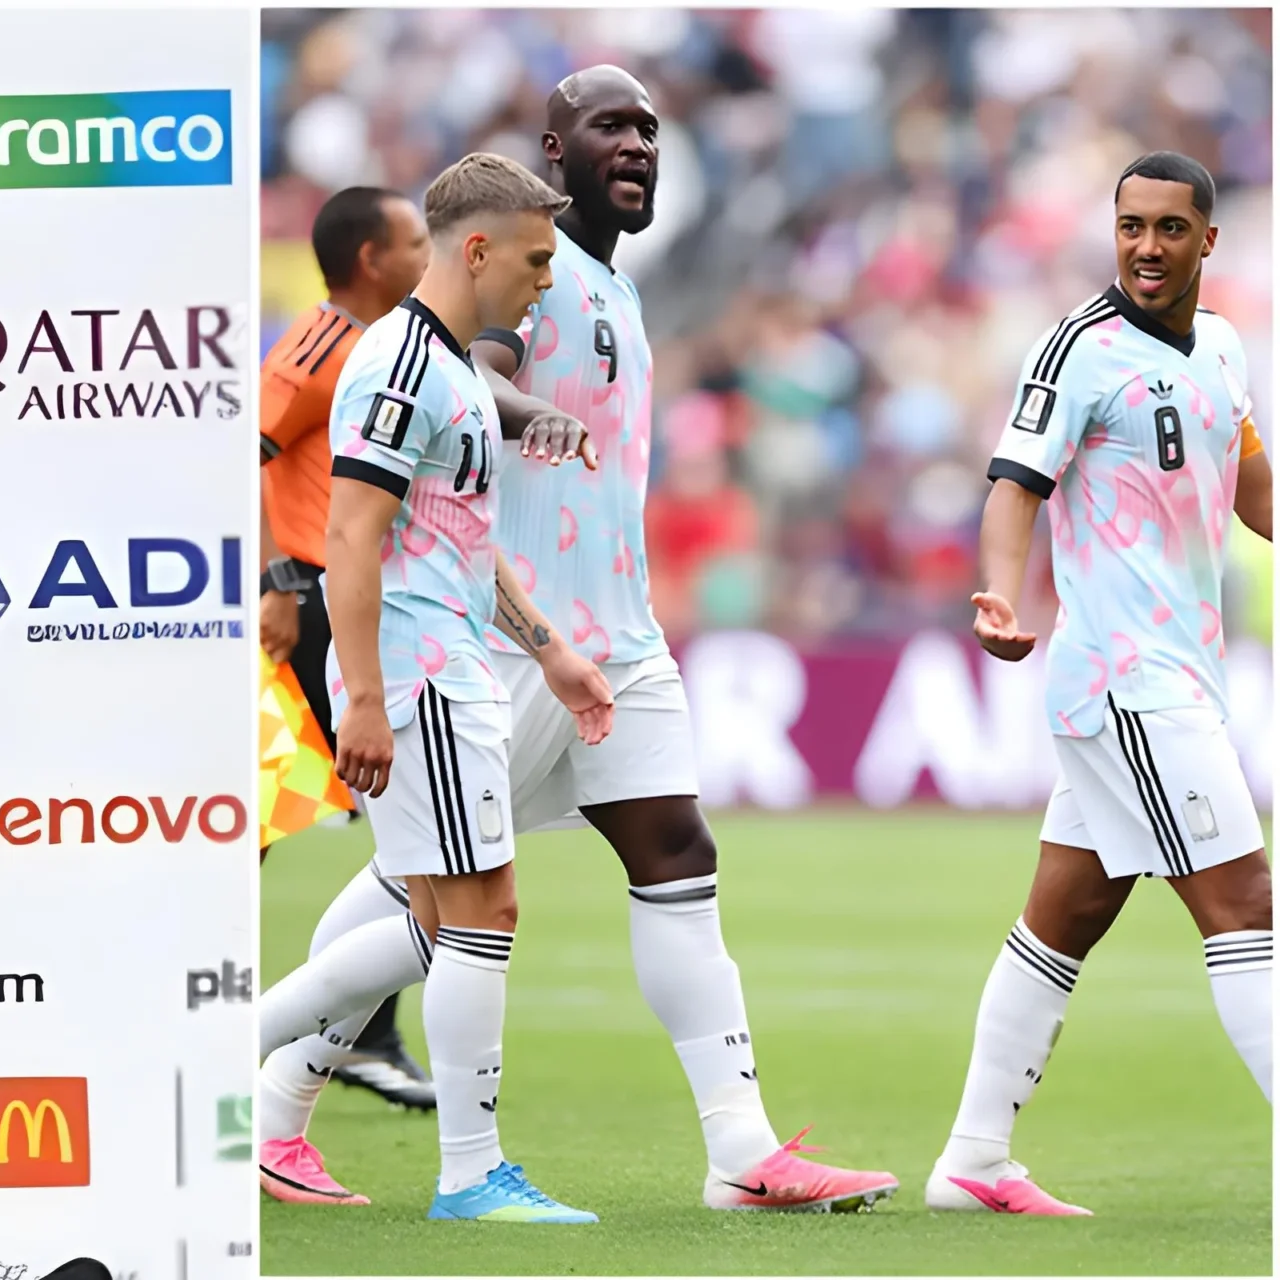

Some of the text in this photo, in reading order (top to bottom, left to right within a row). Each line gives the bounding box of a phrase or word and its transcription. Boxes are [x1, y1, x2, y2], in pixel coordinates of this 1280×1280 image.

[594, 319, 617, 383] 9
[18, 381, 241, 420] AIRWAYS
[1154, 405, 1185, 471] 8
[28, 537, 242, 608] ADI
